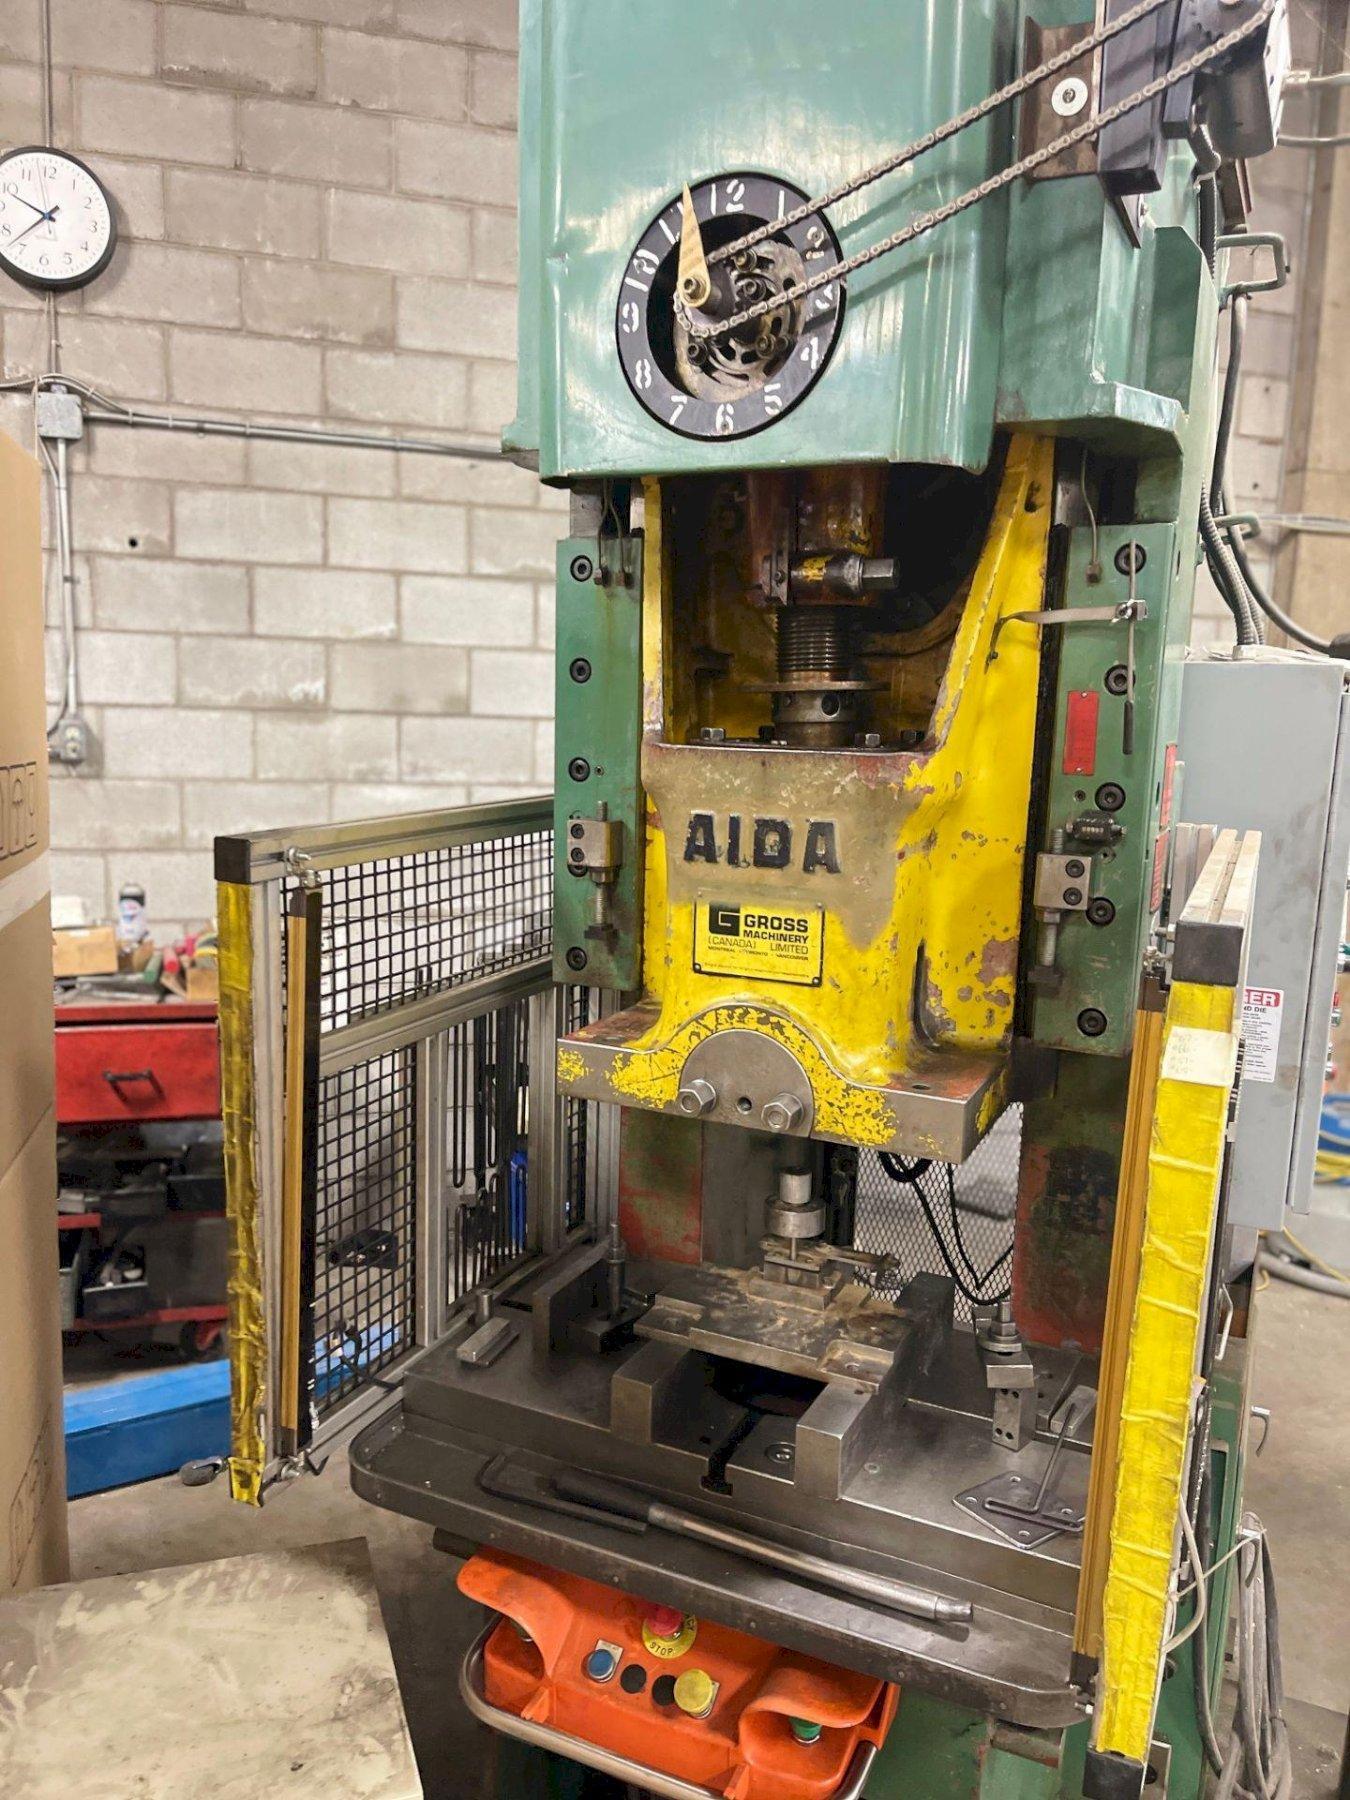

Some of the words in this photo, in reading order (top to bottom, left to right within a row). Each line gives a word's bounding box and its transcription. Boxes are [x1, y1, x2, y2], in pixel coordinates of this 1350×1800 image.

[22, 168, 31, 181] 11
[43, 165, 57, 179] 12
[2, 182, 18, 194] 10
[84, 197, 92, 209] 2
[710, 179, 745, 215] 12
[778, 190, 785, 219] 1
[89, 222, 98, 233] 3
[81, 241, 89, 252] 4
[39, 254, 49, 266] 6
[64, 252, 73, 265] 5
[622, 302, 640, 333] 9
[801, 336, 819, 370] 4
[635, 358, 652, 390] 8
[763, 383, 783, 414] 5
[669, 395, 688, 425] 7
[715, 403, 734, 433] 6
[684, 811, 841, 874] AIDA
[744, 914, 809, 933] GROSS
[708, 936, 756, 949] (CANADA)
[770, 943, 809, 955] LIMITED
[743, 930, 809, 944] MACHINERY
[1244, 990, 1276, 1006] ER
[650, 1641, 674, 1656] STOP
